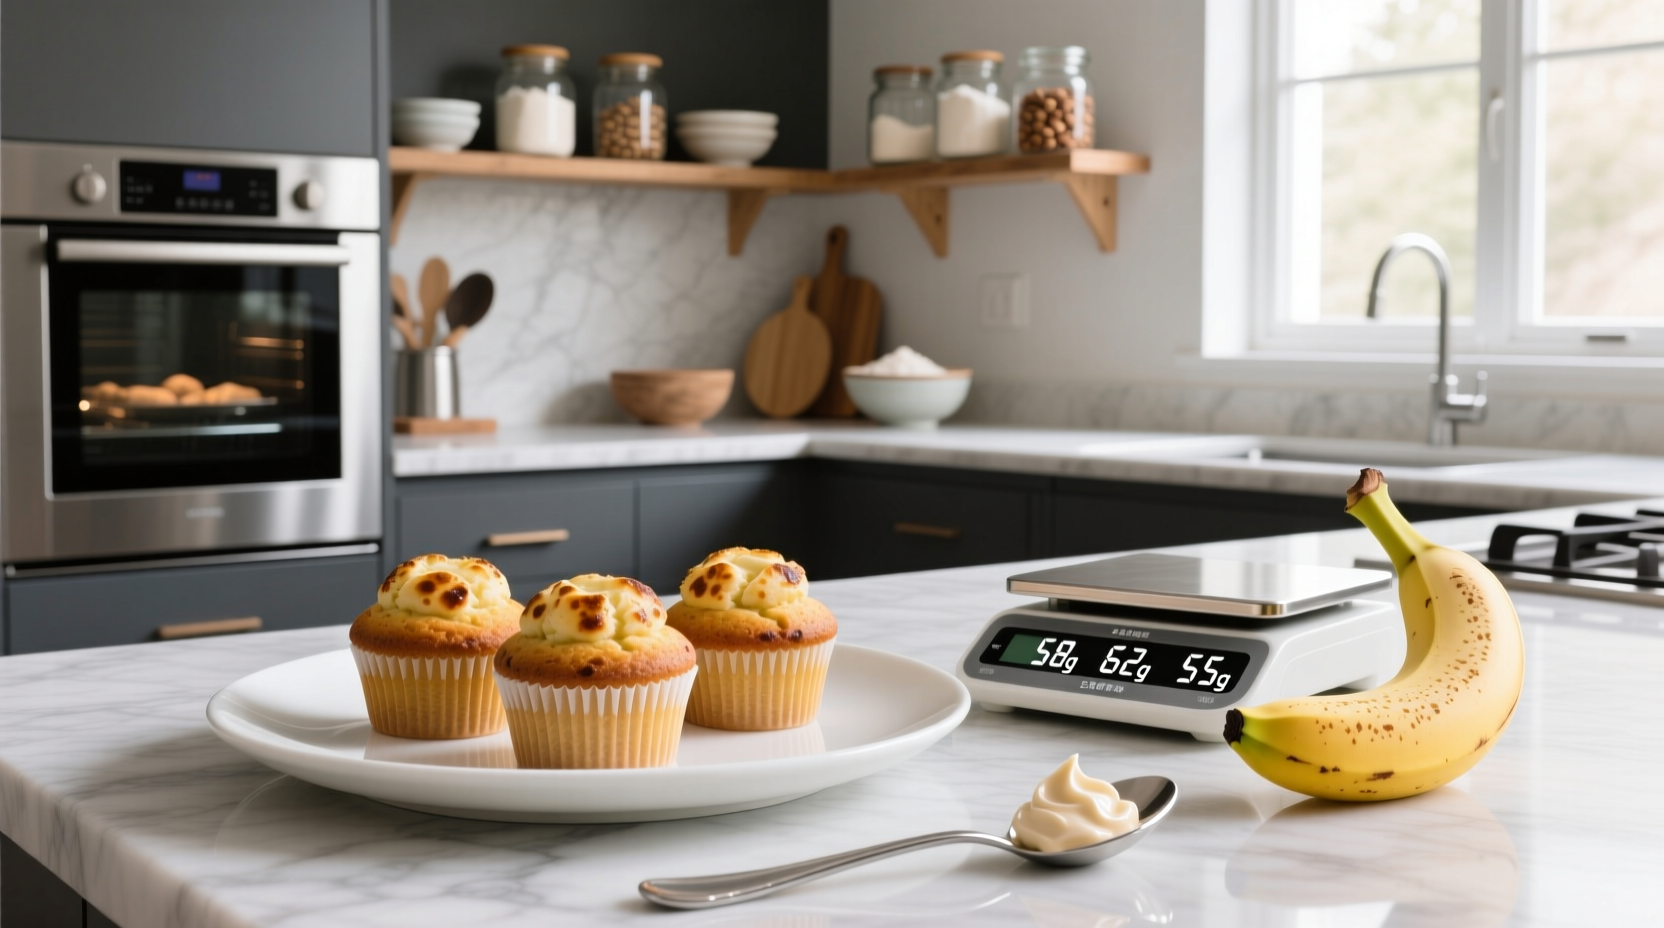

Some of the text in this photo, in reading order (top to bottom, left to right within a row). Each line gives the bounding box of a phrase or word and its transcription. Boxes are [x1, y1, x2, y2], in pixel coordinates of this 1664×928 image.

[1031, 638, 1231, 692] 58g 62g 55g
